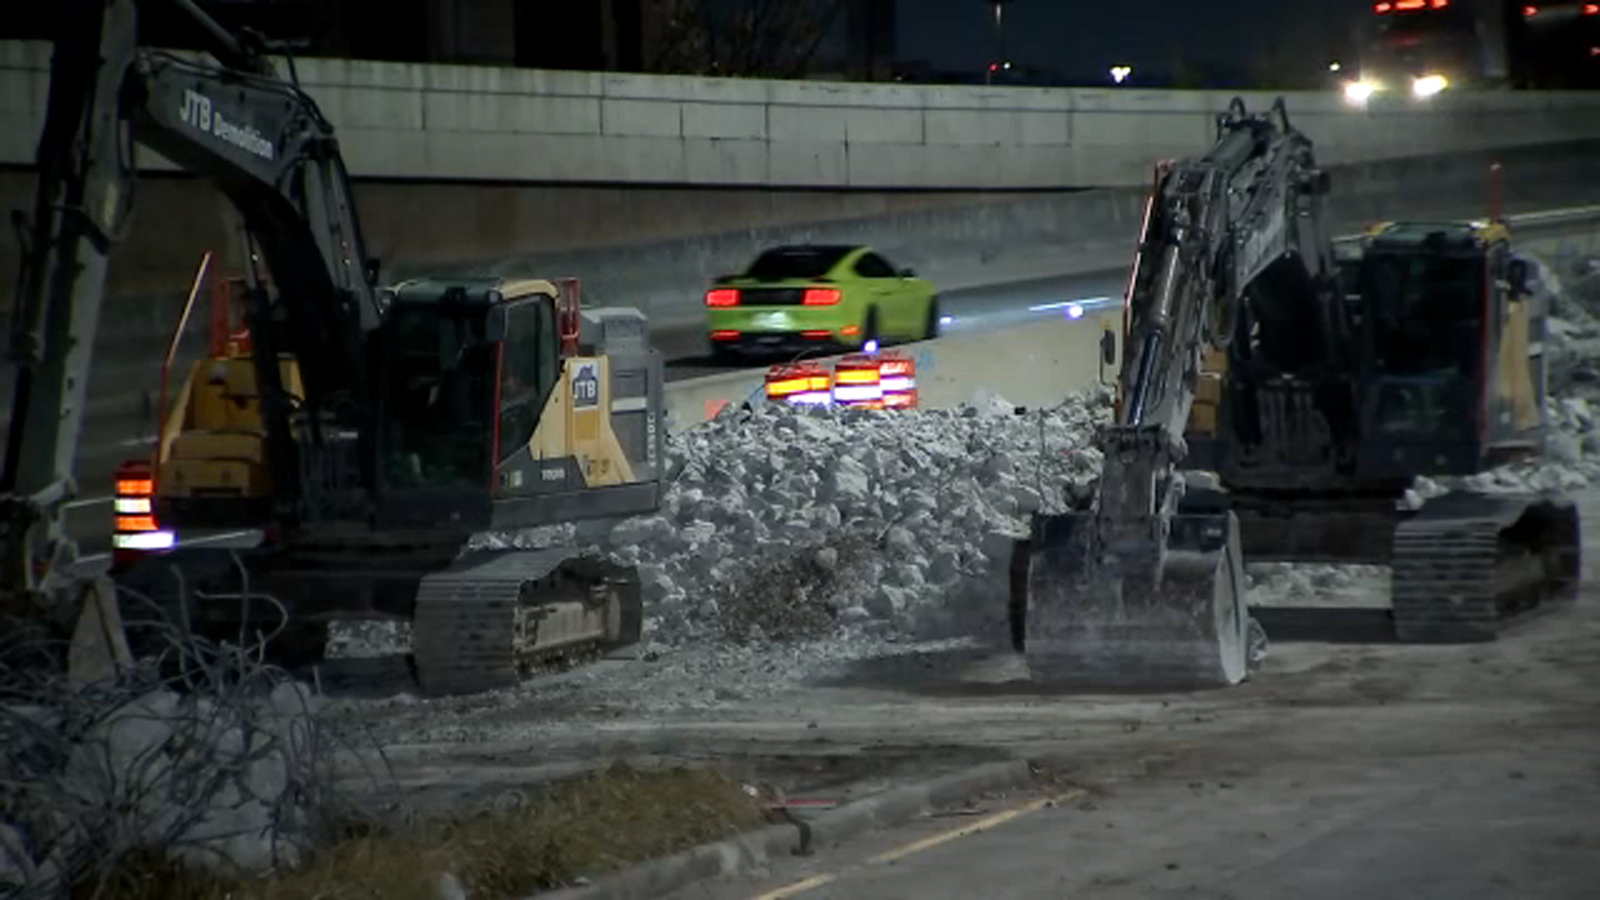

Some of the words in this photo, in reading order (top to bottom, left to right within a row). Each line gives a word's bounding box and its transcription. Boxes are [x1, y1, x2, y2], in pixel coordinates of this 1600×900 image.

[179, 89, 212, 132] JTB
[213, 111, 273, 160] Demolition
[573, 380, 597, 399] JTB
